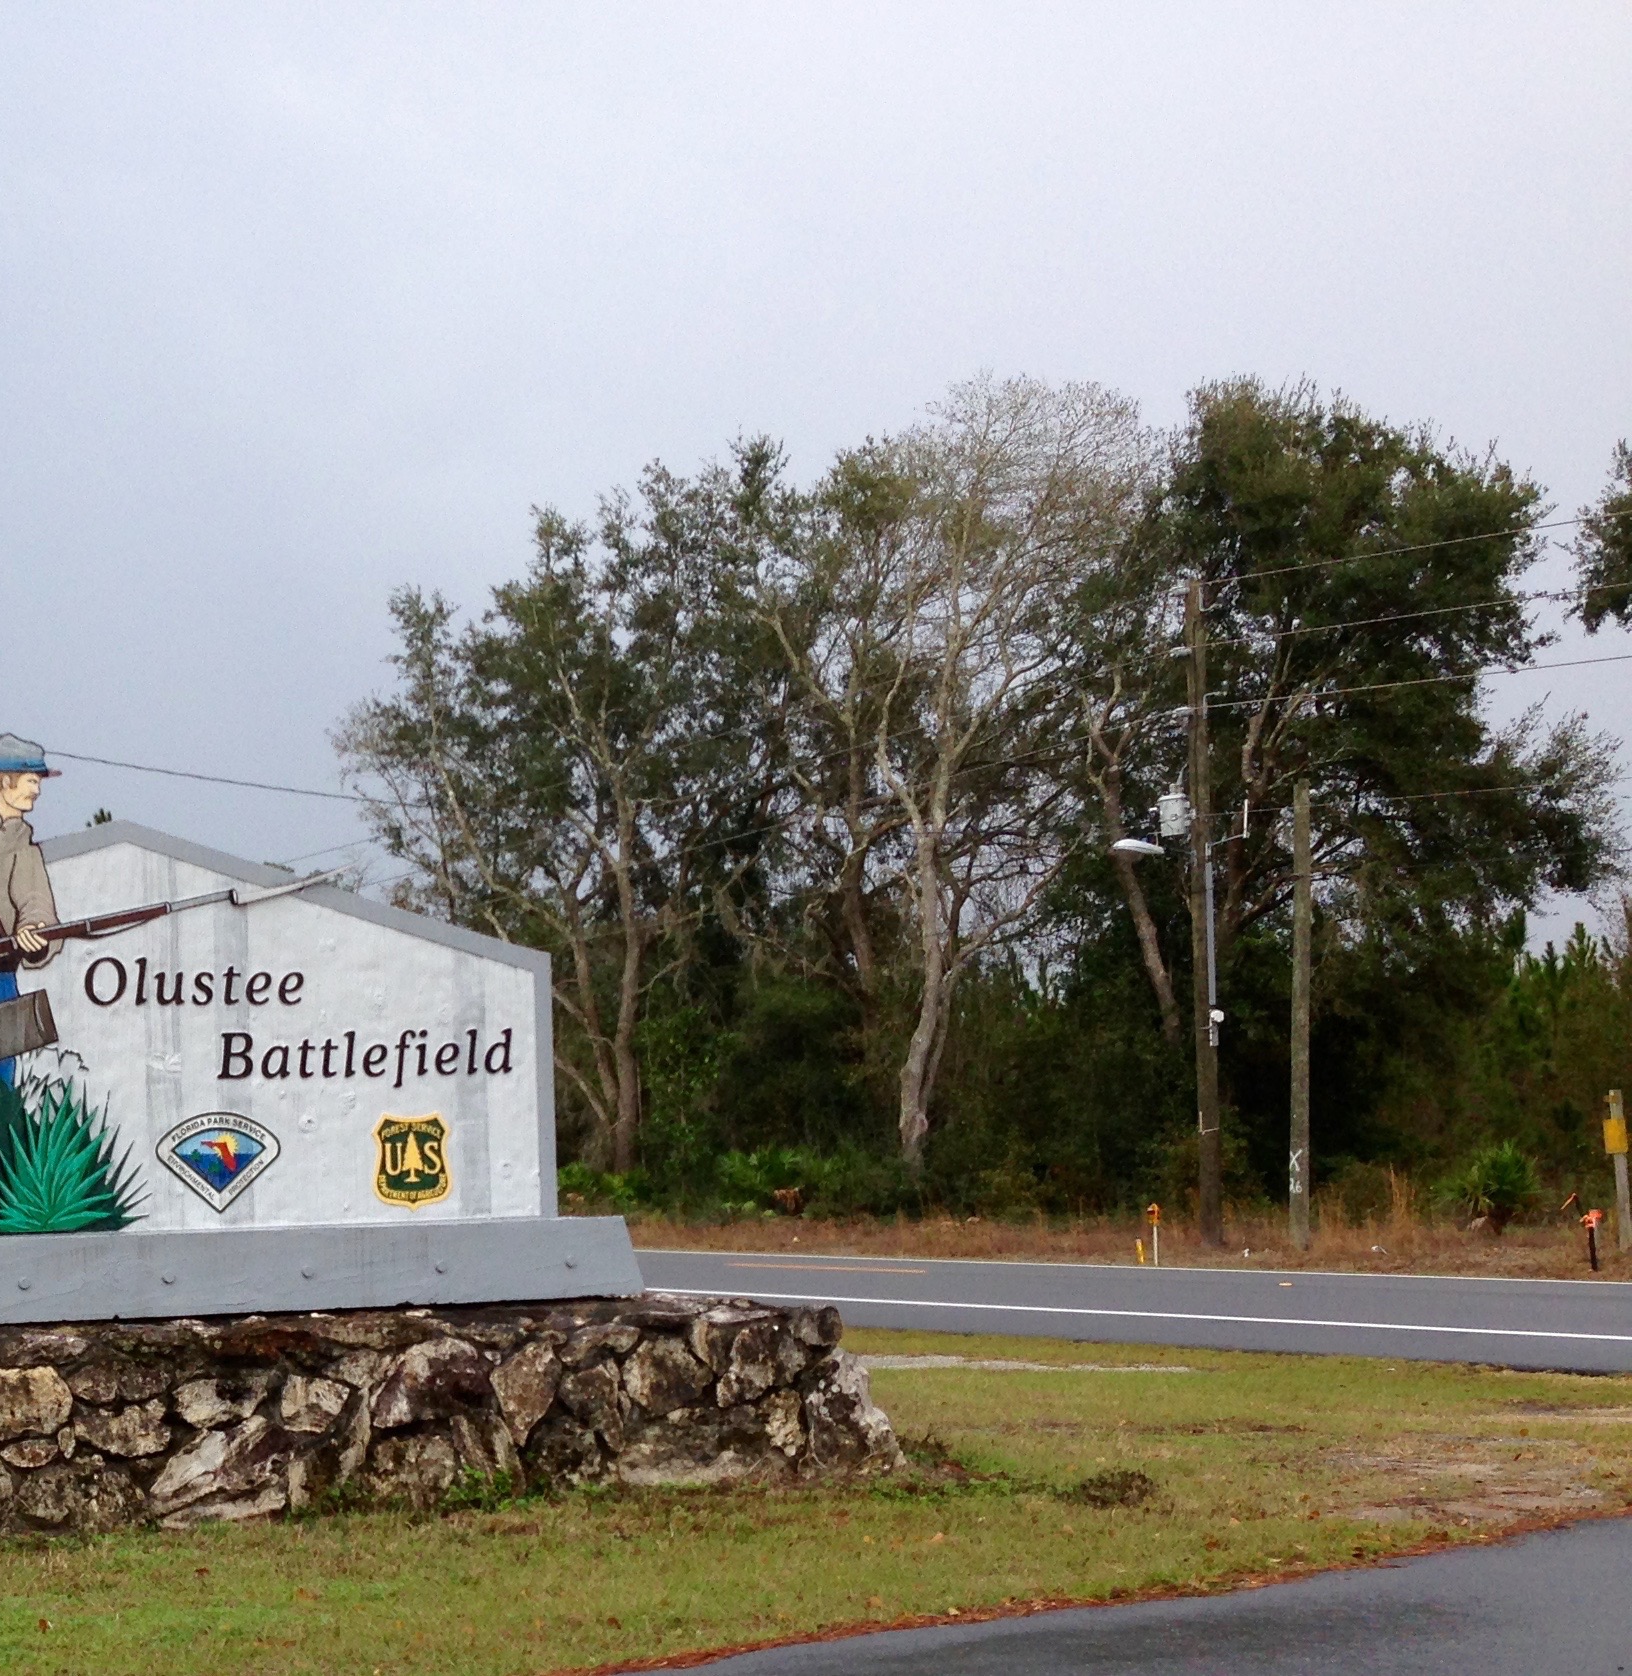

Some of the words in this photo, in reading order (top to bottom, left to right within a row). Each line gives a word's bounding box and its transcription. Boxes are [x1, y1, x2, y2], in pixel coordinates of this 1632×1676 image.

[84, 957, 305, 1007] Olustee
[217, 1028, 514, 1089] Battlefield
[171, 1119, 206, 1142] FLORIDA
[207, 1117, 230, 1126] PARK
[232, 1119, 266, 1142] SERVICE
[381, 1122, 409, 1140] FOREST
[411, 1122, 442, 1140] SERVICE
[166, 1155, 215, 1201] ENVIRONMENTAL
[229, 1159, 265, 1196] PROTECTION
